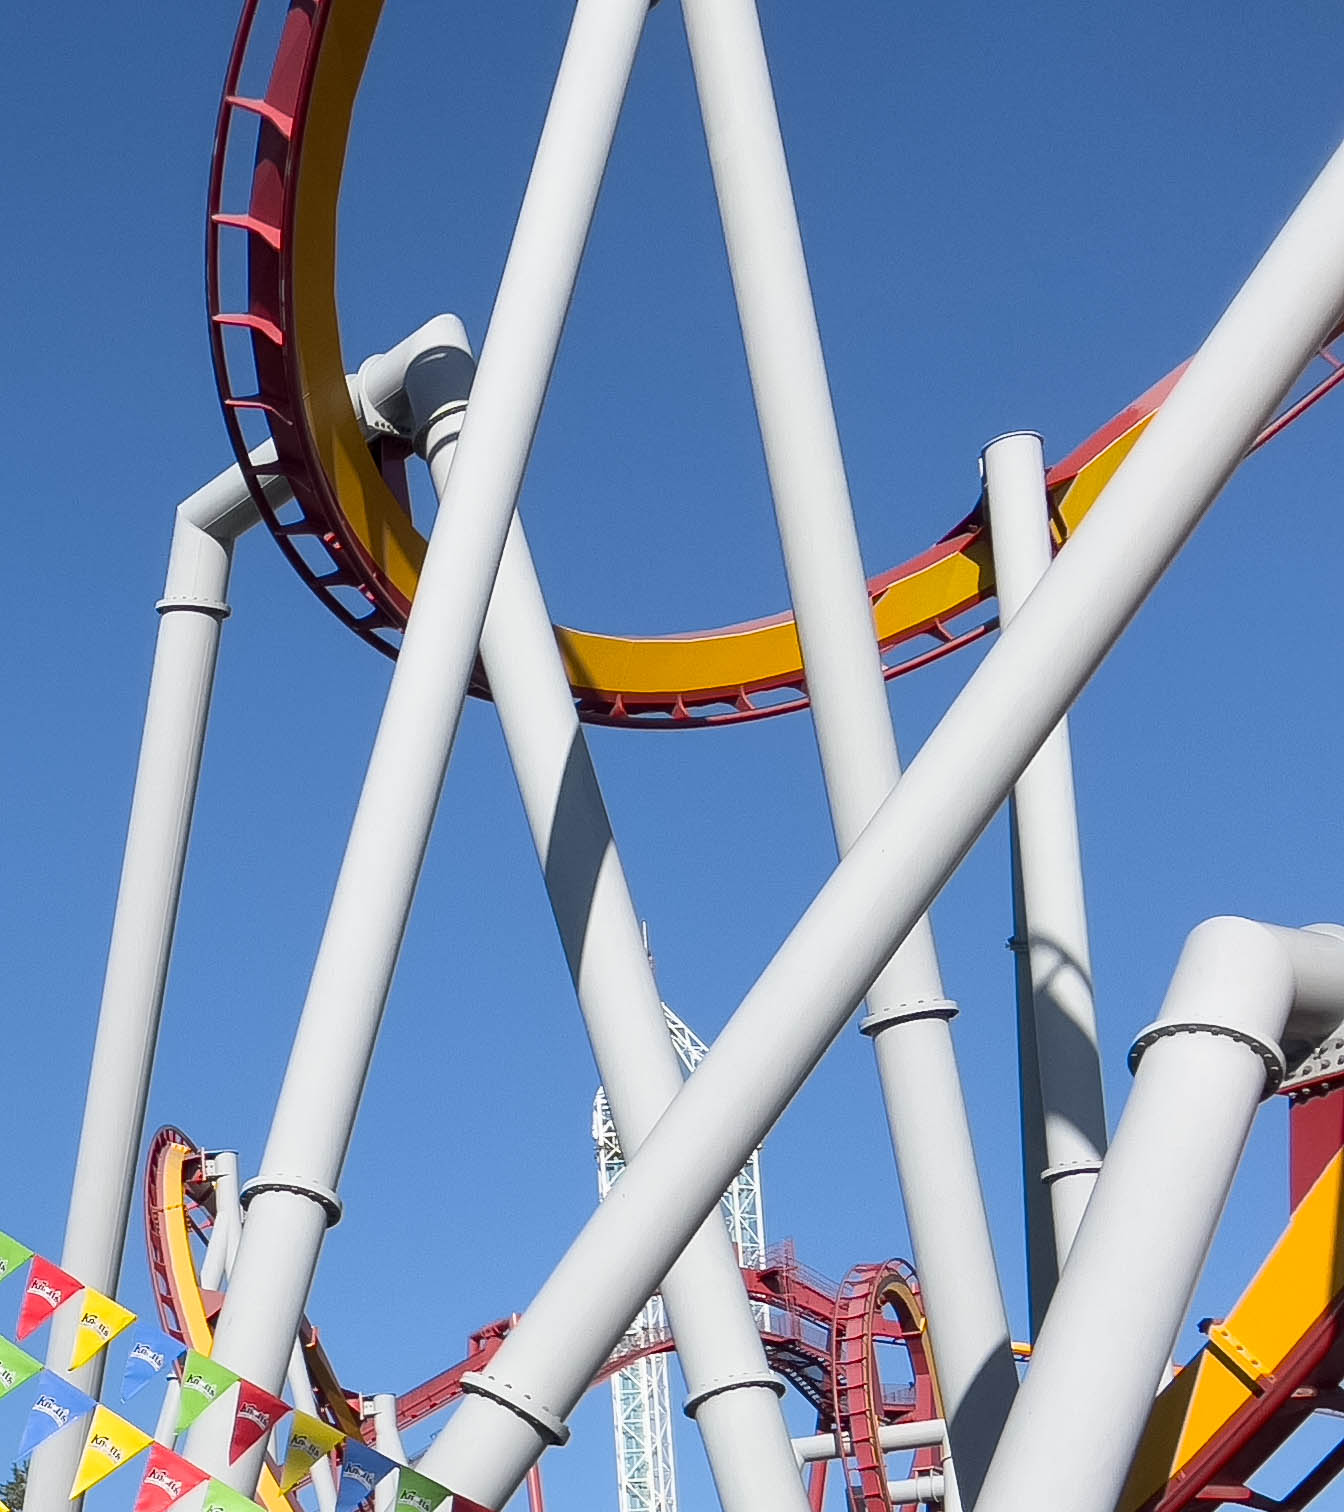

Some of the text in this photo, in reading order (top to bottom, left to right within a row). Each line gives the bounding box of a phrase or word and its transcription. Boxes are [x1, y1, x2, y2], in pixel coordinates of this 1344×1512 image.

[31, 1280, 60, 1304] Kntt's
[81, 1313, 109, 1337] Kntt's
[133, 1344, 163, 1366] Kntt's
[187, 1374, 216, 1397] Kntt's
[36, 1396, 66, 1422] Kntt's
[241, 1403, 269, 1427] Kntt's
[91, 1434, 120, 1462] Kntt's
[291, 1434, 320, 1458] Kntt's
[148, 1469, 180, 1494] Kntt's
[344, 1463, 374, 1486] Kntt's
[400, 1489, 430, 1512] Kntt's
